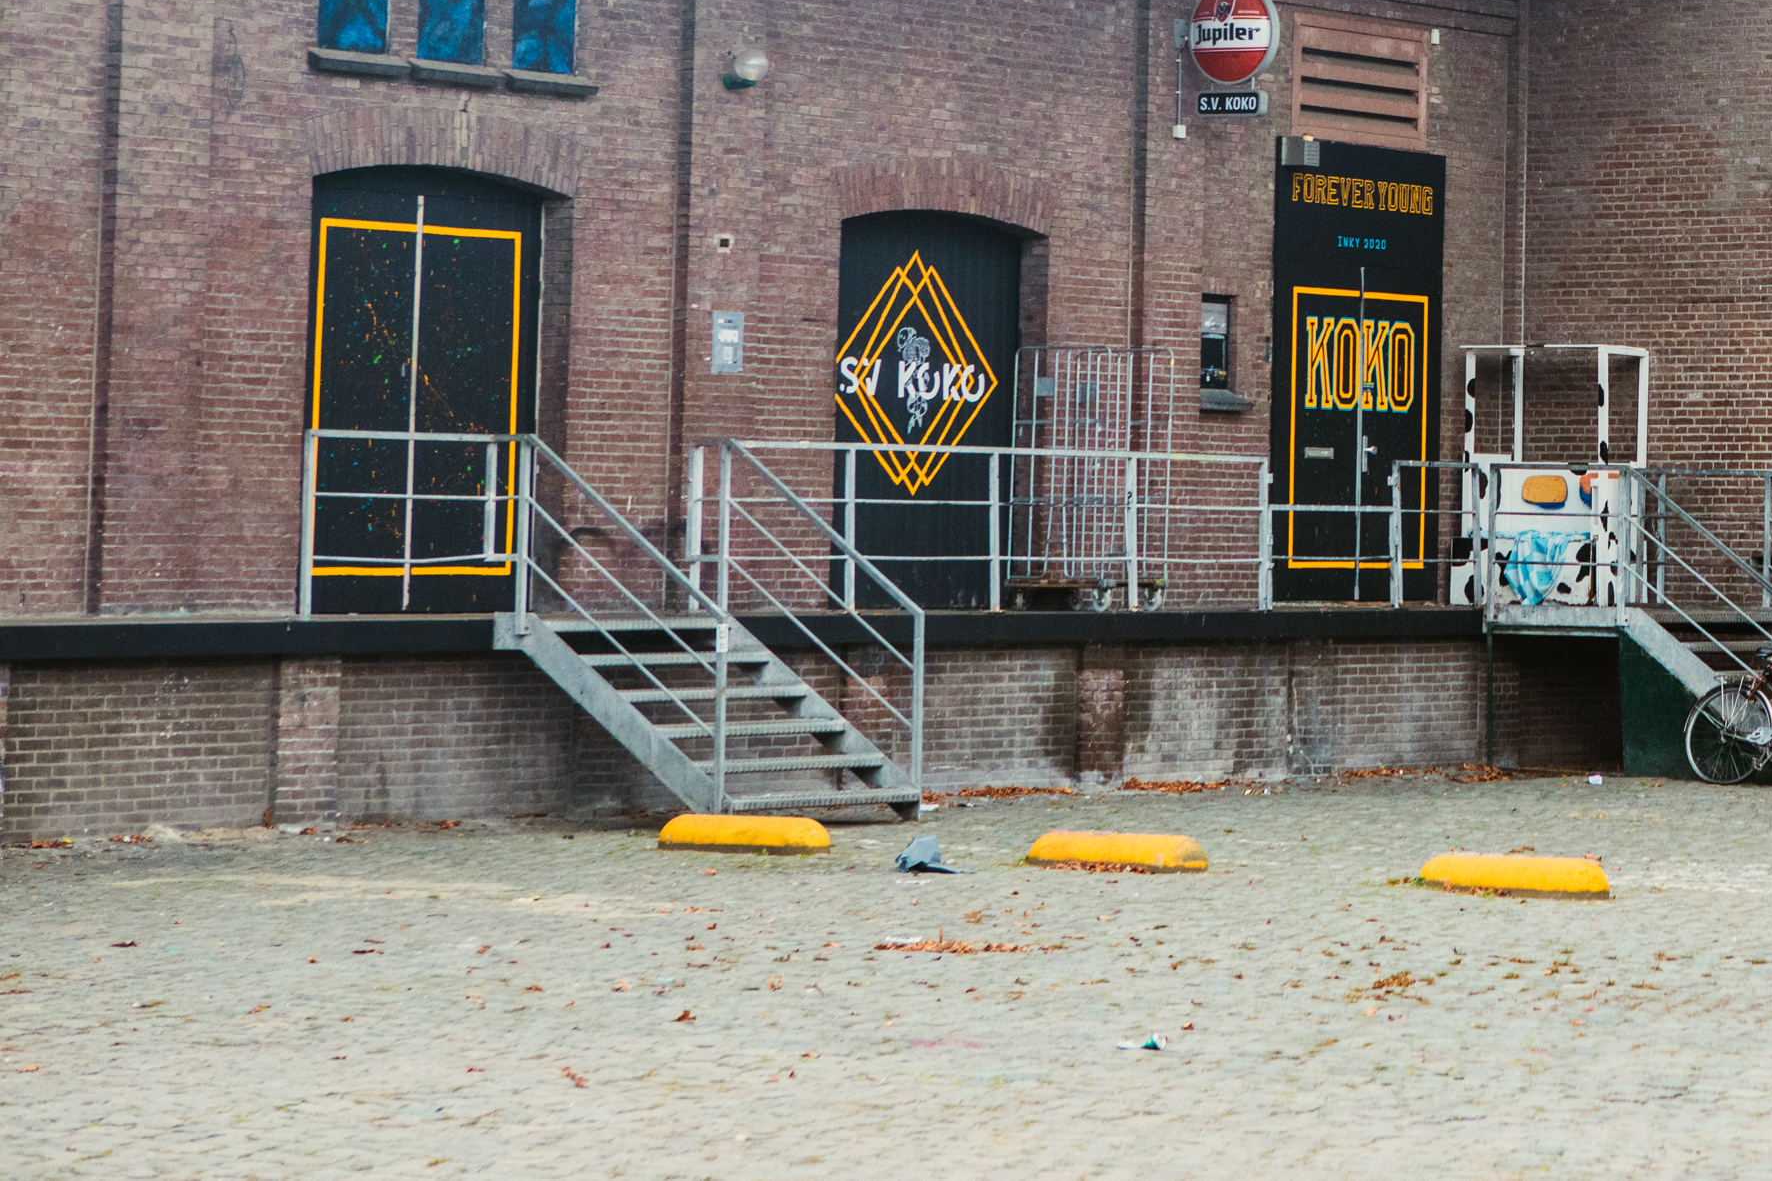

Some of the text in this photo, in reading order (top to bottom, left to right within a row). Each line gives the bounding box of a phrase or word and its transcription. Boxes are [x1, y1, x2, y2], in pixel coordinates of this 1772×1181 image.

[1195, 22, 1261, 46] Jupiler
[1199, 96, 1257, 111] S.V. KOKO
[1292, 172, 1433, 216] FOREVER YOUNG
[1337, 235, 1387, 250] INKY 2020
[1304, 315, 1415, 414] KOKO
[897, 360, 986, 403] KOKO
